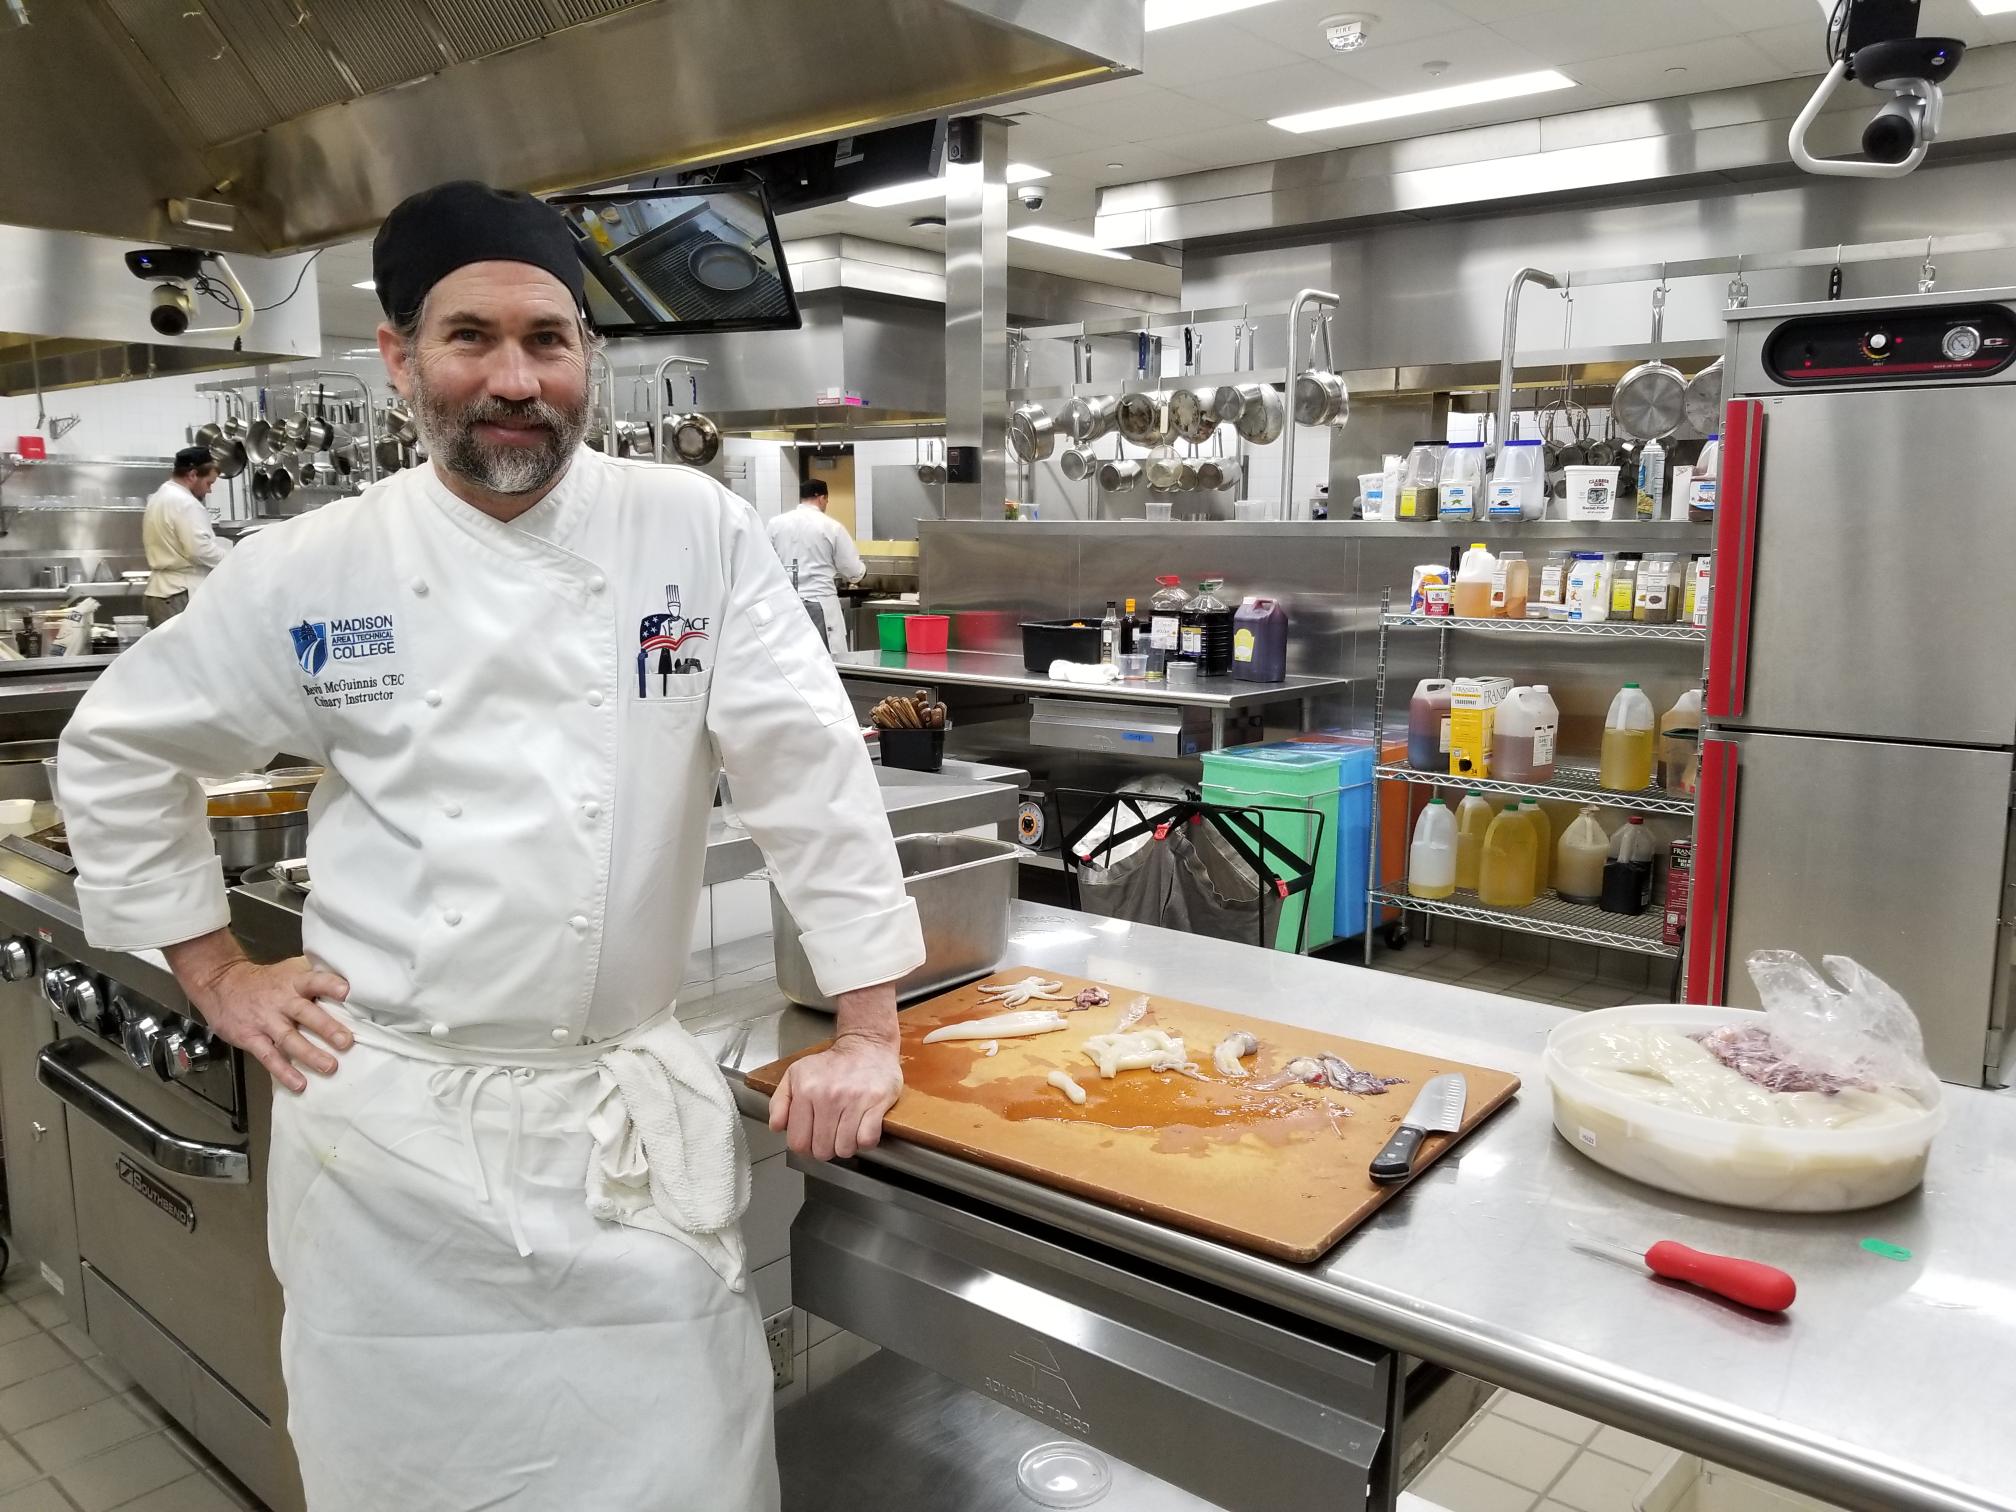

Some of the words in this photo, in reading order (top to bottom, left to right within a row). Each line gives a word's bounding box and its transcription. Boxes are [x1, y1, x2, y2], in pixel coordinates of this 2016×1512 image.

[1335, 25, 1352, 34] FIRE
[330, 615, 393, 633] MADISON
[684, 617, 710, 631] ACF
[332, 635, 352, 644] AREA
[356, 630, 394, 642] TECHNICAL
[333, 642, 396, 660] COLLEGE
[324, 677, 377, 693] McGuinnis
[382, 673, 405, 686] CEC
[345, 690, 394, 705] Instructor
[134, 1172, 187, 1223] SOUTHBEND
[985, 1376, 1044, 1415] ADVANCE
[1046, 1404, 1090, 1434] TABCO
